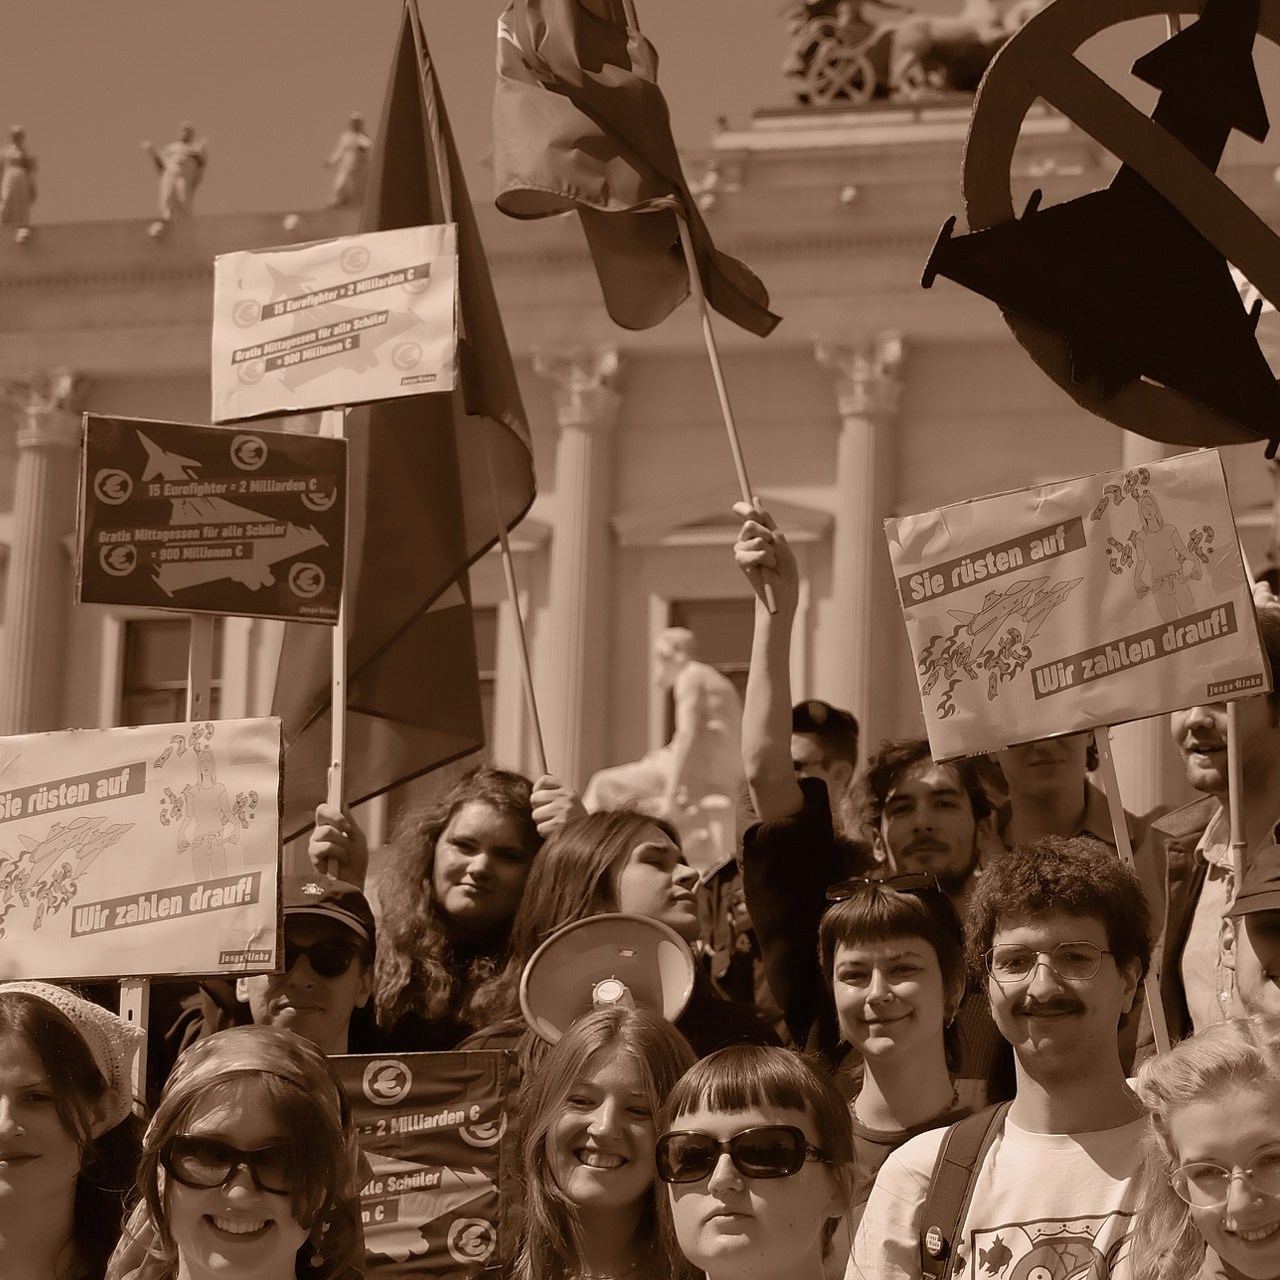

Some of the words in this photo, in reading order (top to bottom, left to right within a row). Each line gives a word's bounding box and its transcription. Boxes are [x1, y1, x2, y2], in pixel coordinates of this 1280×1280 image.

[274, 303, 284, 315] 15
[286, 291, 337, 311] Eurofighter
[348, 284, 354, 295] 2
[356, 273, 404, 293] Milliarden
[235, 347, 261, 362] Gratis
[264, 332, 316, 354] Mittagessen
[318, 327, 331, 339] für
[334, 323, 351, 335] alle
[353, 314, 387, 331] Schüler
[284, 354, 300, 366] 900
[302, 342, 343, 360] Millionen
[149, 484, 160, 497] 15
[164, 482, 227, 497] Eurofighter
[239, 481, 246, 492] 2
[250, 479, 306, 493] Milliarden
[99, 530, 132, 543] Gratis
[135, 528, 200, 542] Mittagessen
[203, 526, 218, 538] für
[222, 525, 243, 537] alle
[246, 523, 286, 537] Schüler
[159, 547, 180, 560] 900
[182, 546, 232, 560] Millionen
[909, 572, 944, 601] Sie
[951, 549, 1024, 588] rüsten
[1030, 526, 1067, 560] auf
[1035, 665, 1075, 695] Wir
[1081, 641, 1157, 679] zahlen
[1163, 607, 1229, 652] drauf!
[27, 782, 90, 814] rüsten
[96, 769, 130, 798] auf
[74, 903, 110, 933] Wir
[114, 895, 182, 926] zahlen
[190, 876, 253, 912] drauf!
[376, 1120, 387, 1136] 2
[390, 1109, 465, 1135] Milliarden
[387, 1172, 440, 1192] Schüler
